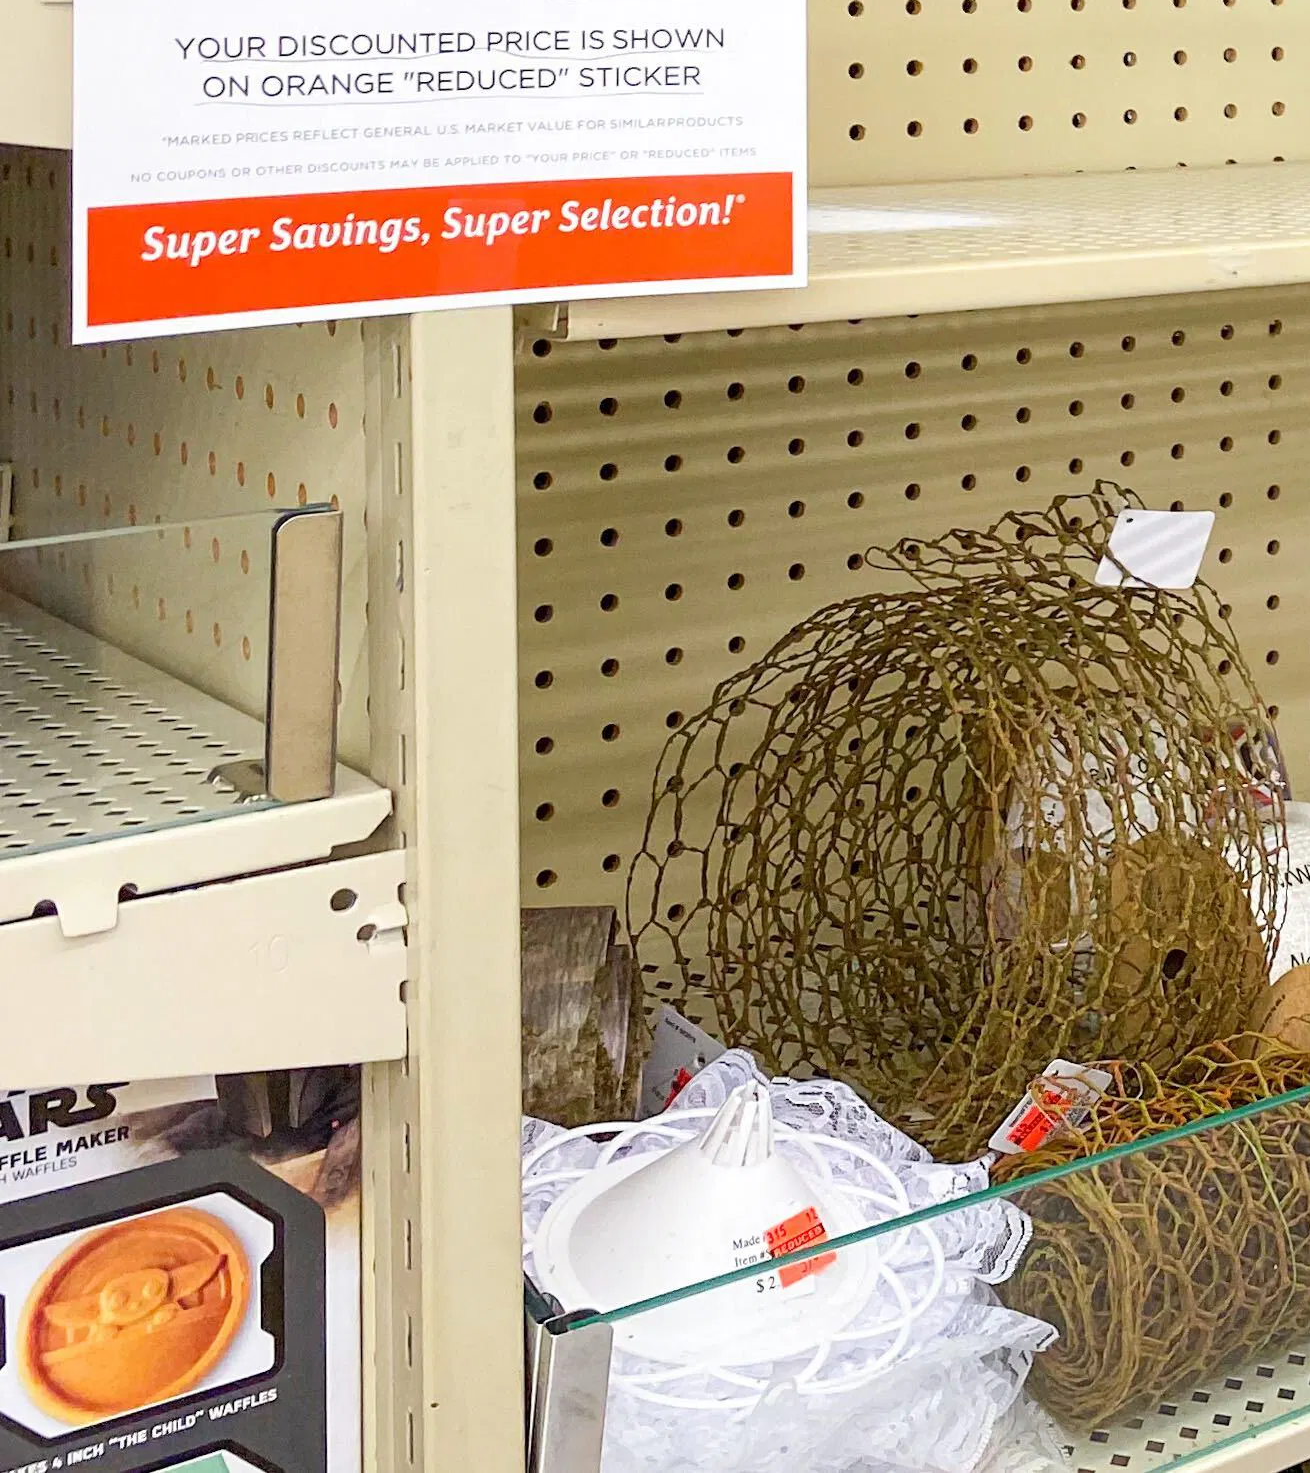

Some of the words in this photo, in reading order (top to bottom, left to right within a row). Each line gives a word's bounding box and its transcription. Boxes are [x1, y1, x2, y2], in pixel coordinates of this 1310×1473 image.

[175, 37, 267, 60] YOUR
[279, 32, 477, 58] DISCOUNTED
[487, 30, 571, 53] PRICE
[582, 29, 605, 51] IS
[613, 28, 725, 50] SHOWN
[203, 76, 250, 99] ON
[261, 72, 395, 97] ORANGE
[404, 67, 569, 93] "REDUCED"
[579, 66, 702, 88] STICKER
[236, 129, 290, 143] PRICES
[293, 127, 359, 141] REFLECT
[363, 125, 432, 139] GENERAL
[437, 121, 460, 135] U.S.
[465, 121, 524, 135] MARKET
[528, 119, 574, 133] VALUE
[577, 119, 606, 131] FOR
[130, 172, 152, 184] NO
[156, 167, 227, 183] COUPONS
[231, 166, 252, 178] OR
[255, 163, 303, 177] OTHER
[307, 159, 386, 174] DISCOUNTS
[390, 158, 420, 170] MAY
[423, 157, 441, 169] BE
[444, 154, 499, 168] APPLIED
[503, 154, 522, 166] TO
[620, 149, 641, 161] OR
[719, 146, 758, 158] ITEMS
[141, 224, 260, 268] Super
[269, 209, 431, 253] Savings,
[441, 204, 551, 247] Super
[56, 1125, 130, 1157] MAKER
[12, 1156, 78, 1183] WAFFLES
[733, 1235, 761, 1251] Made
[734, 1253, 758, 1268] Item
[67, 1443, 105, 1468] INCH
[208, 1387, 279, 1422] WAFFLES
